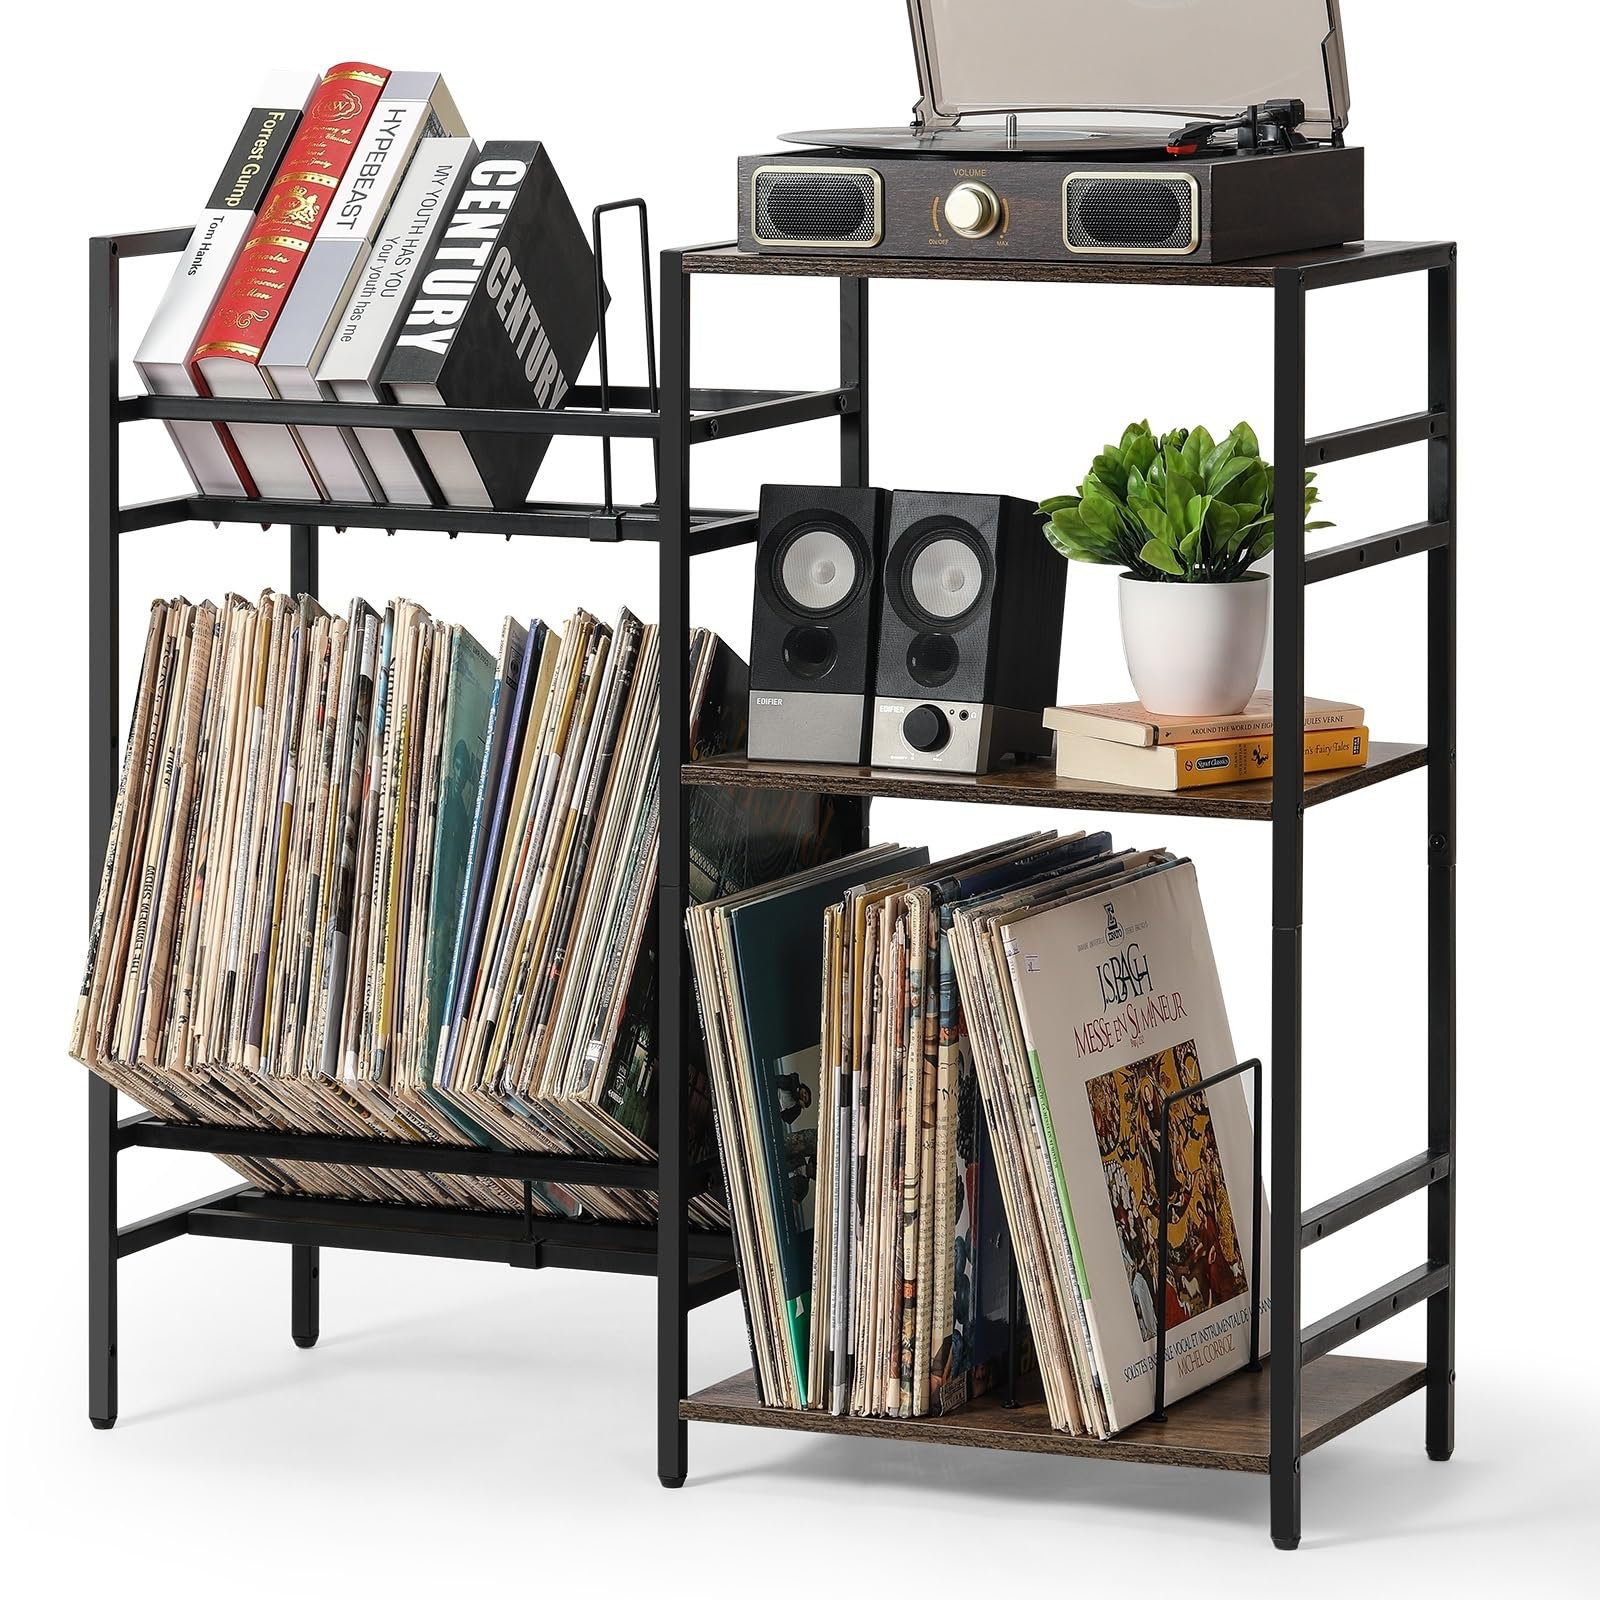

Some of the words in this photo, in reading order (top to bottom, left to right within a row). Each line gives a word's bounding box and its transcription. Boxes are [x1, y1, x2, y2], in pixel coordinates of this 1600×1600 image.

[248, 111, 286, 160] Forrest
[337, 109, 406, 230] HYPEBEAST
[432, 165, 453, 186] MY
[953, 168, 987, 177] VOLUME
[224, 164, 260, 207] Gump
[408, 189, 440, 235] YOUTH
[202, 215, 225, 240] Tom
[188, 242, 212, 276] Hanks
[376, 236, 401, 264] Your
[394, 238, 420, 266] HAS
[397, 160, 527, 355] CENTURY
[360, 264, 382, 297] youth
[380, 270, 407, 298] YOU
[350, 300, 371, 322] has
[340, 323, 358, 343] me
[486, 246, 569, 410] CENTURY
[756, 697, 783, 706] EDIFIER
[879, 704, 905, 714] EDIFIER
[1191, 728, 1216, 736] AROUND
[1231, 723, 1252, 732] WORLD
[1304, 716, 1322, 726] JULES
[1323, 716, 1344, 724] VERNE
[134, 901, 150, 949] EMINEM
[143, 865, 156, 900] SHOW
[1073, 1018, 1114, 1058] MESSE
[1113, 1013, 1128, 1042] EN
[1126, 1003, 1142, 1040] SI
[1140, 992, 1188, 1031] MINEUR
[1124, 1358, 1148, 1382] SOLISTES
[1173, 1336, 1192, 1356] VOCAL
[1191, 1332, 1198, 1348] ET
[1177, 1350, 1204, 1378] MICHEL
[1203, 1334, 1236, 1364] CORBOZ
